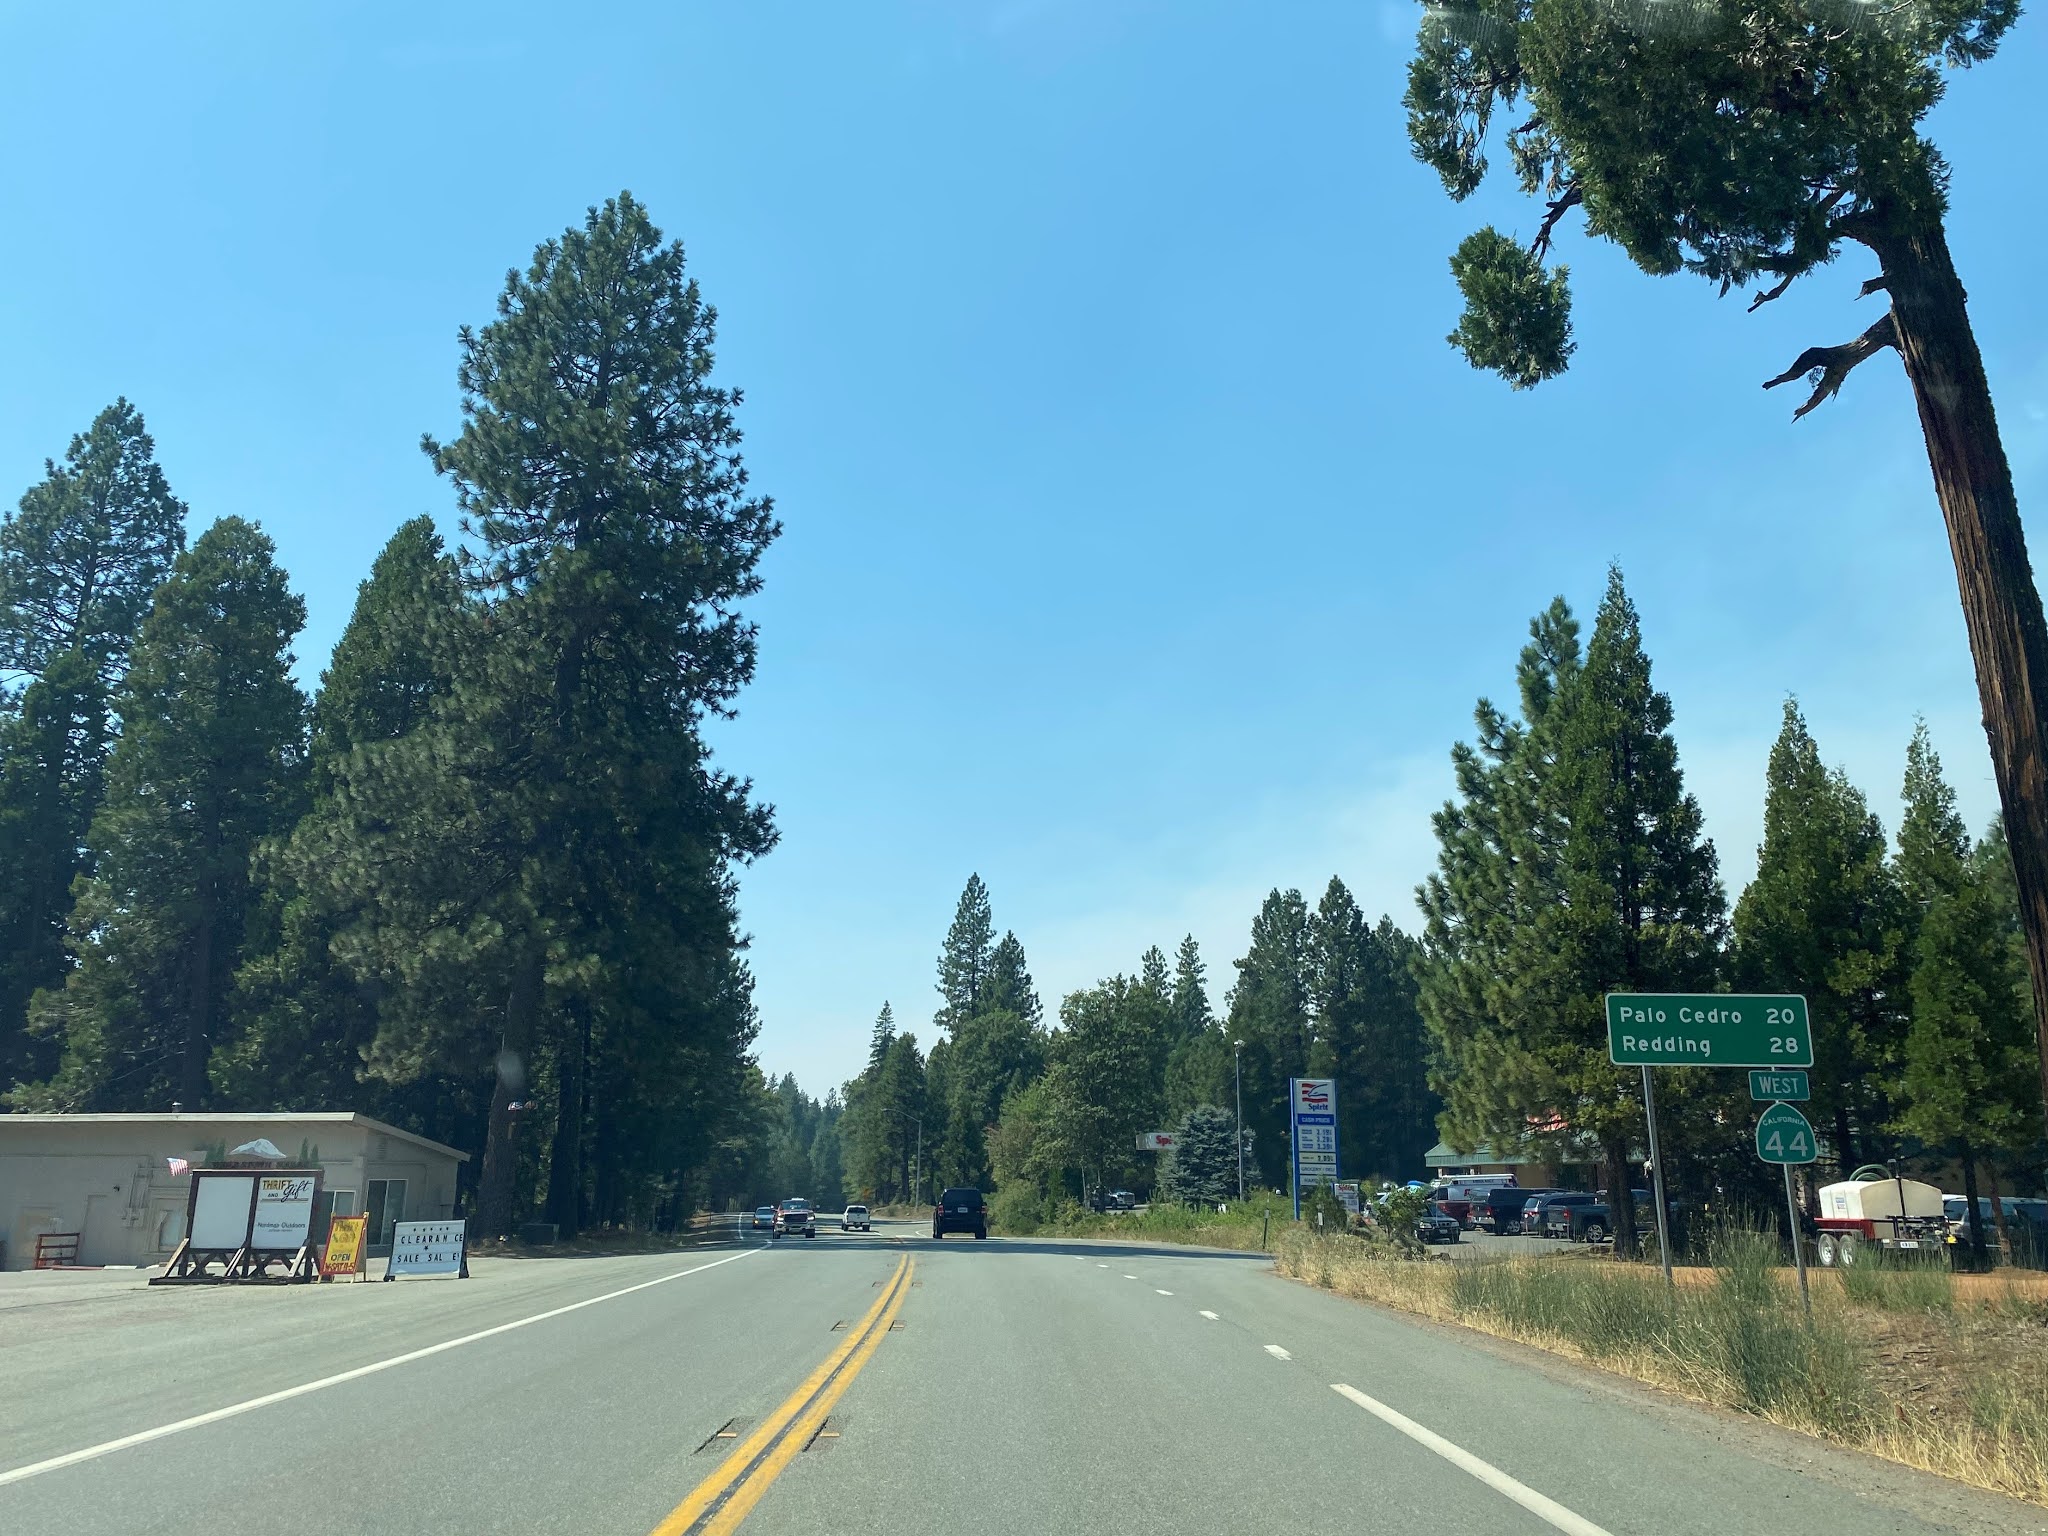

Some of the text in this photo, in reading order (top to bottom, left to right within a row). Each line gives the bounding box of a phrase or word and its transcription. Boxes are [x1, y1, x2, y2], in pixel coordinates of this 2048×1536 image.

[1620, 1007, 1795, 1024] Palo Cedro 20
[1623, 1036, 1799, 1057] Redding 28
[1759, 1076, 1799, 1093] WEST
[1308, 1103, 1328, 1111] Spirit
[1762, 1116, 1805, 1126] CALIFORNIA
[1765, 1130, 1808, 1157] 44
[262, 1179, 292, 1190] THRIFT
[331, 1253, 351, 1261] OPEN
[397, 1254, 419, 1263] SALE
